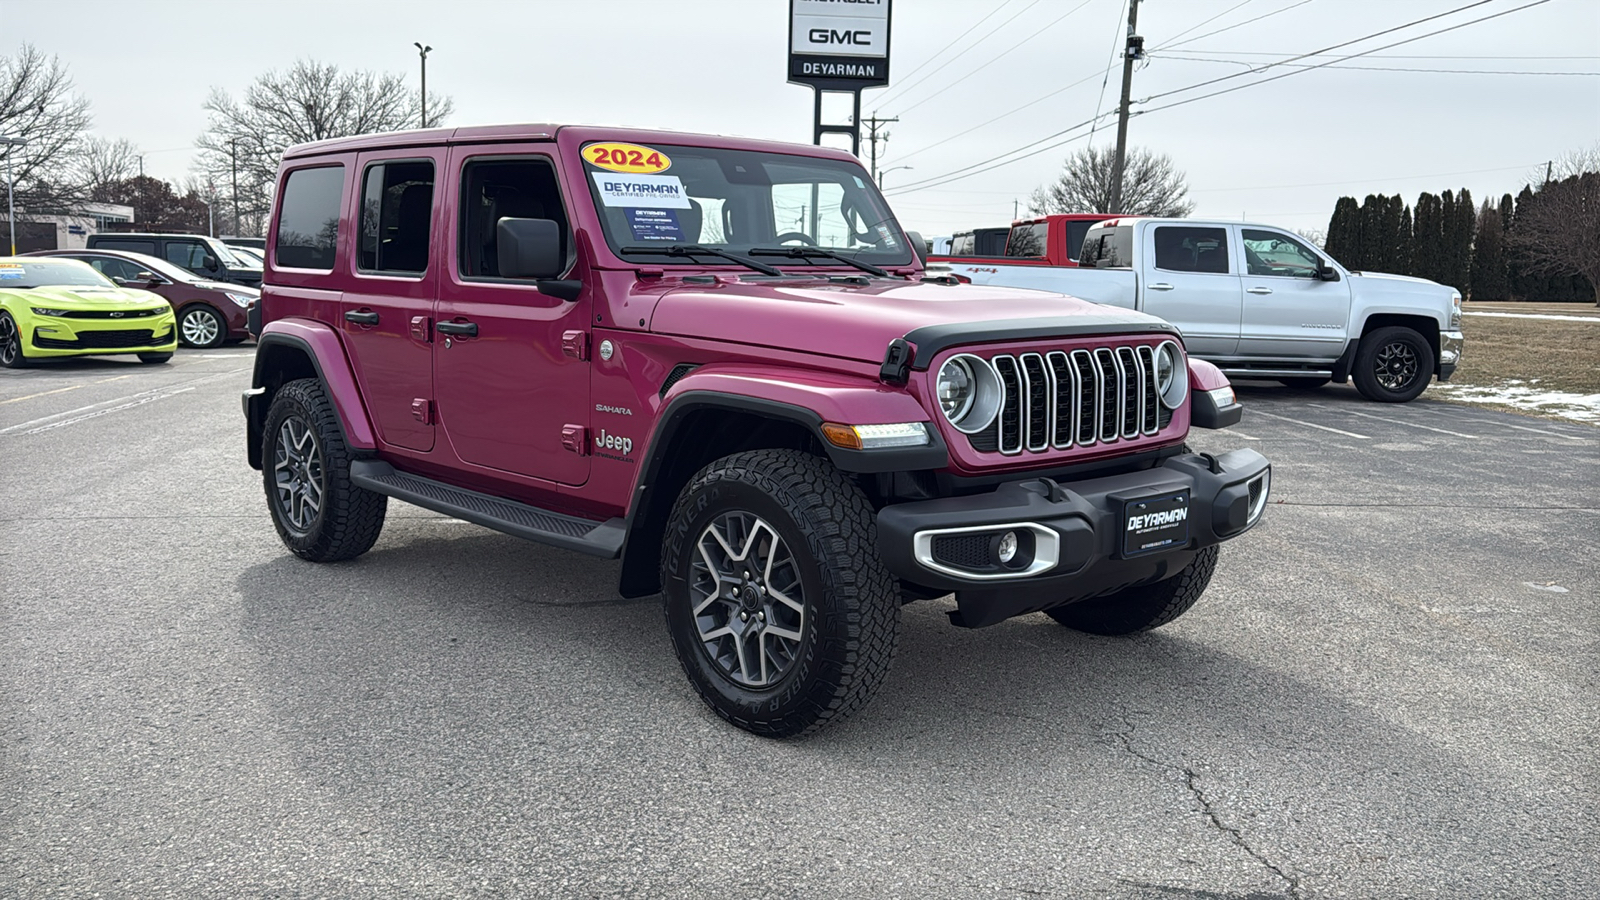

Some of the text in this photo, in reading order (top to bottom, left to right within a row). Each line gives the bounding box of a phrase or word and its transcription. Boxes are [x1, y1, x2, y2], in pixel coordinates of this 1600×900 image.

[809, 28, 871, 45] GMC
[803, 62, 875, 76] DEYARMAN
[593, 147, 663, 168] 2024
[604, 182, 679, 194] DEYARMAN
[595, 404, 632, 416] SAHARA
[595, 429, 632, 456] Jeep
[1127, 507, 1188, 531] DEYARMAN
[769, 604, 818, 712] GRABBER
